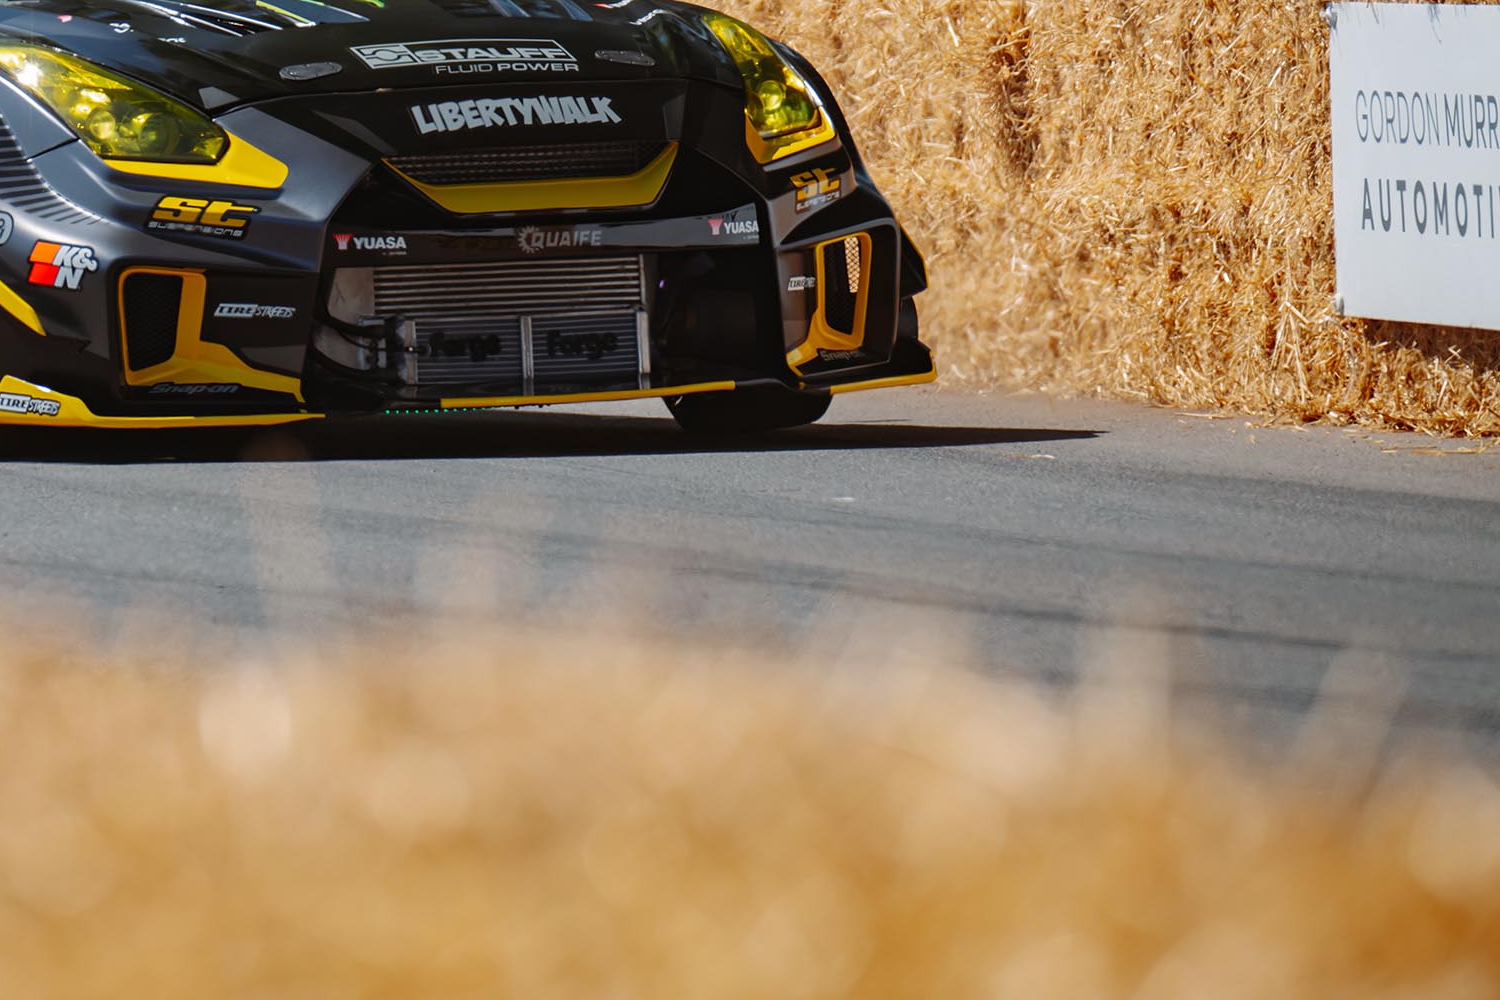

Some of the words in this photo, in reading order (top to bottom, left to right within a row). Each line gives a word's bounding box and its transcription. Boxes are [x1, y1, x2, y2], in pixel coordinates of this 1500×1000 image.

[416, 47, 567, 62] STAUFF
[435, 64, 493, 75] FLUID
[498, 62, 580, 72] POWER
[411, 95, 622, 134] LIBERTYWALK
[1355, 89, 1441, 146] GORDON
[1361, 178, 1500, 240] AUTOMOTI
[724, 220, 760, 235] YUASA
[353, 236, 407, 250] YUASA
[529, 229, 602, 249] QUAIFE
